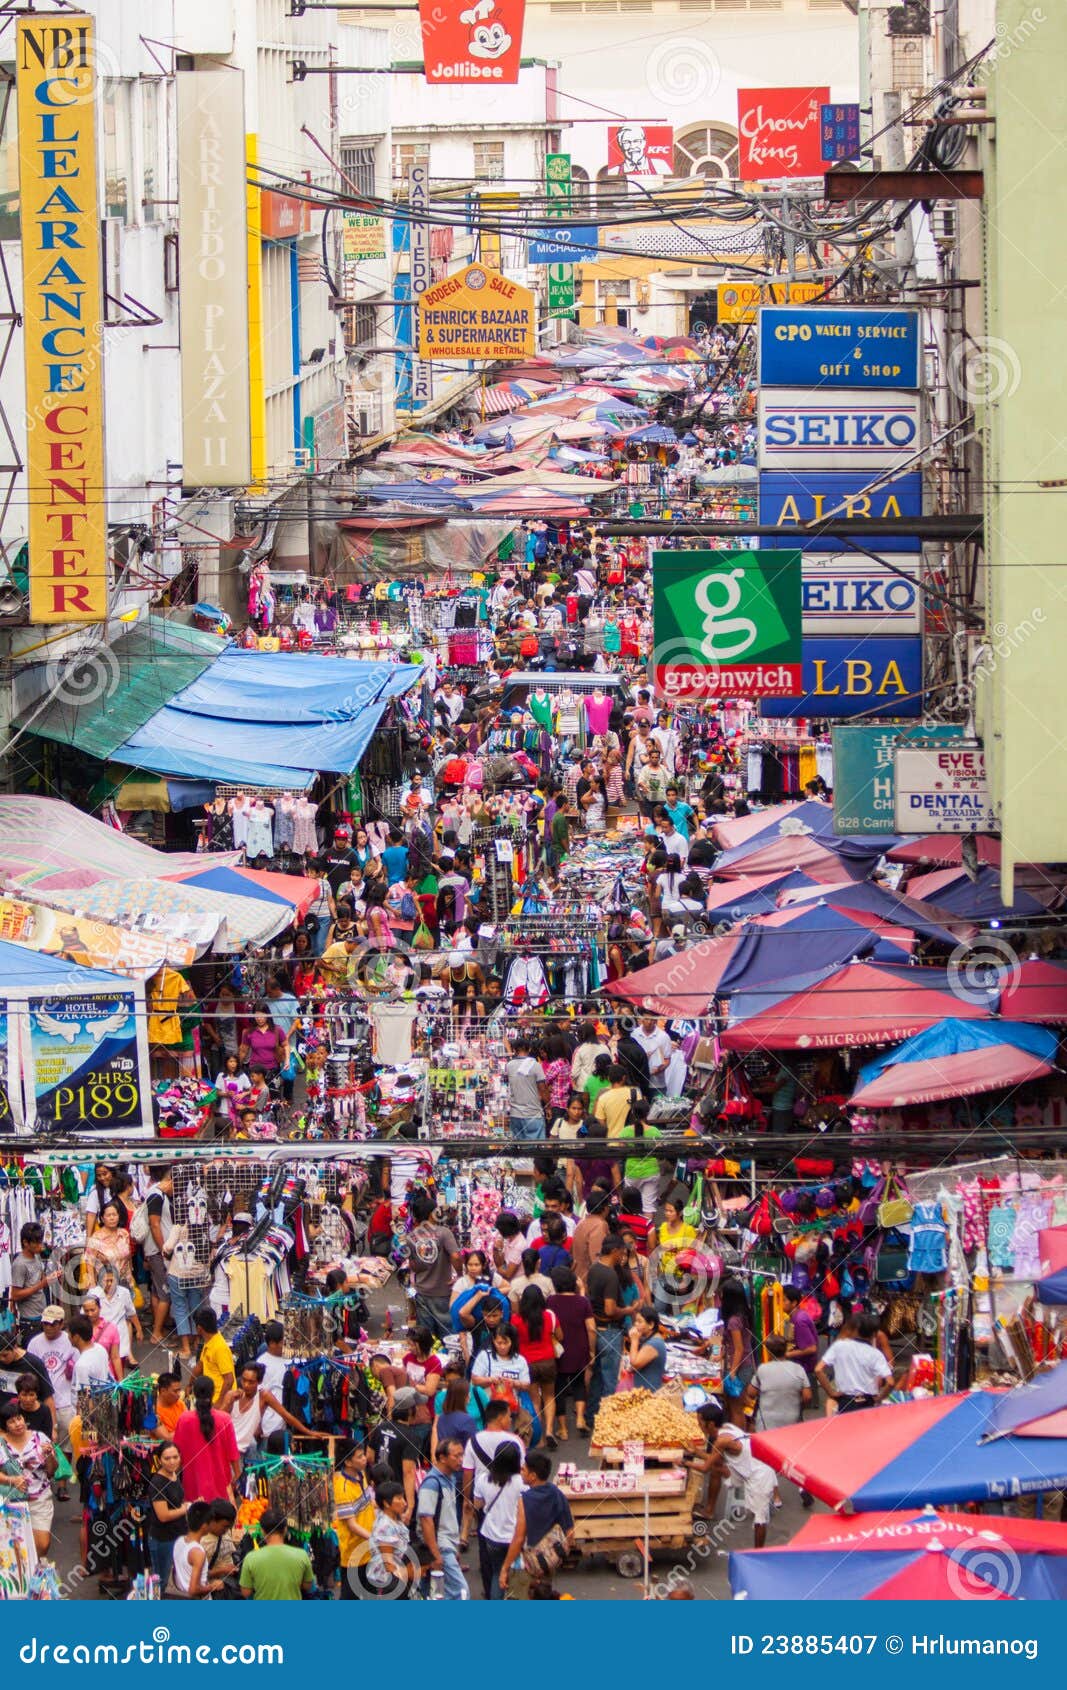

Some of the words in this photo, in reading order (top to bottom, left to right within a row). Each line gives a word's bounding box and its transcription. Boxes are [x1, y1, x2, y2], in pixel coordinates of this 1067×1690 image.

[21, 27, 90, 70] NBI
[432, 61, 503, 78] Jollibee
[740, 105, 808, 138] Chow
[647, 145, 670, 154] KFC
[748, 136, 799, 168] king
[348, 219, 361, 227] WE
[363, 218, 379, 226] BUY
[34, 77, 86, 393] CLEARANCE
[425, 279, 462, 306] BODEGA
[490, 278, 516, 299] SALE
[424, 310, 477, 324] HENRICK
[481, 310, 528, 324] BAZAAR
[426, 328, 434, 343] &
[438, 328, 527, 343] SUPERMARKET
[774, 324, 812, 341] CPO
[815, 325, 851, 337] WATCH
[857, 327, 908, 338] SERVICE
[484, 347, 491, 355] &
[203, 303, 228, 423] PLAZA
[819, 364, 851, 376] GIFT
[863, 365, 901, 376] SHOP
[765, 415, 916, 446] SEIKO
[43, 406, 96, 613] CENTER
[802, 580, 916, 611] EIKO
[664, 666, 793, 697] greenwich
[802, 660, 909, 695] LBA
[938, 753, 974, 769] EYE
[910, 795, 984, 808] DENTAL
[943, 809, 981, 817] ZENAIDA
[838, 817, 860, 828] 628
[65, 1003, 98, 1012] HOTEL
[815, 1028, 918, 1047] MICROMATIC
[87, 1071, 137, 1085] 2HRS.
[911, 1079, 1014, 1104] MICROMATIC
[54, 1083, 138, 1121] P189
